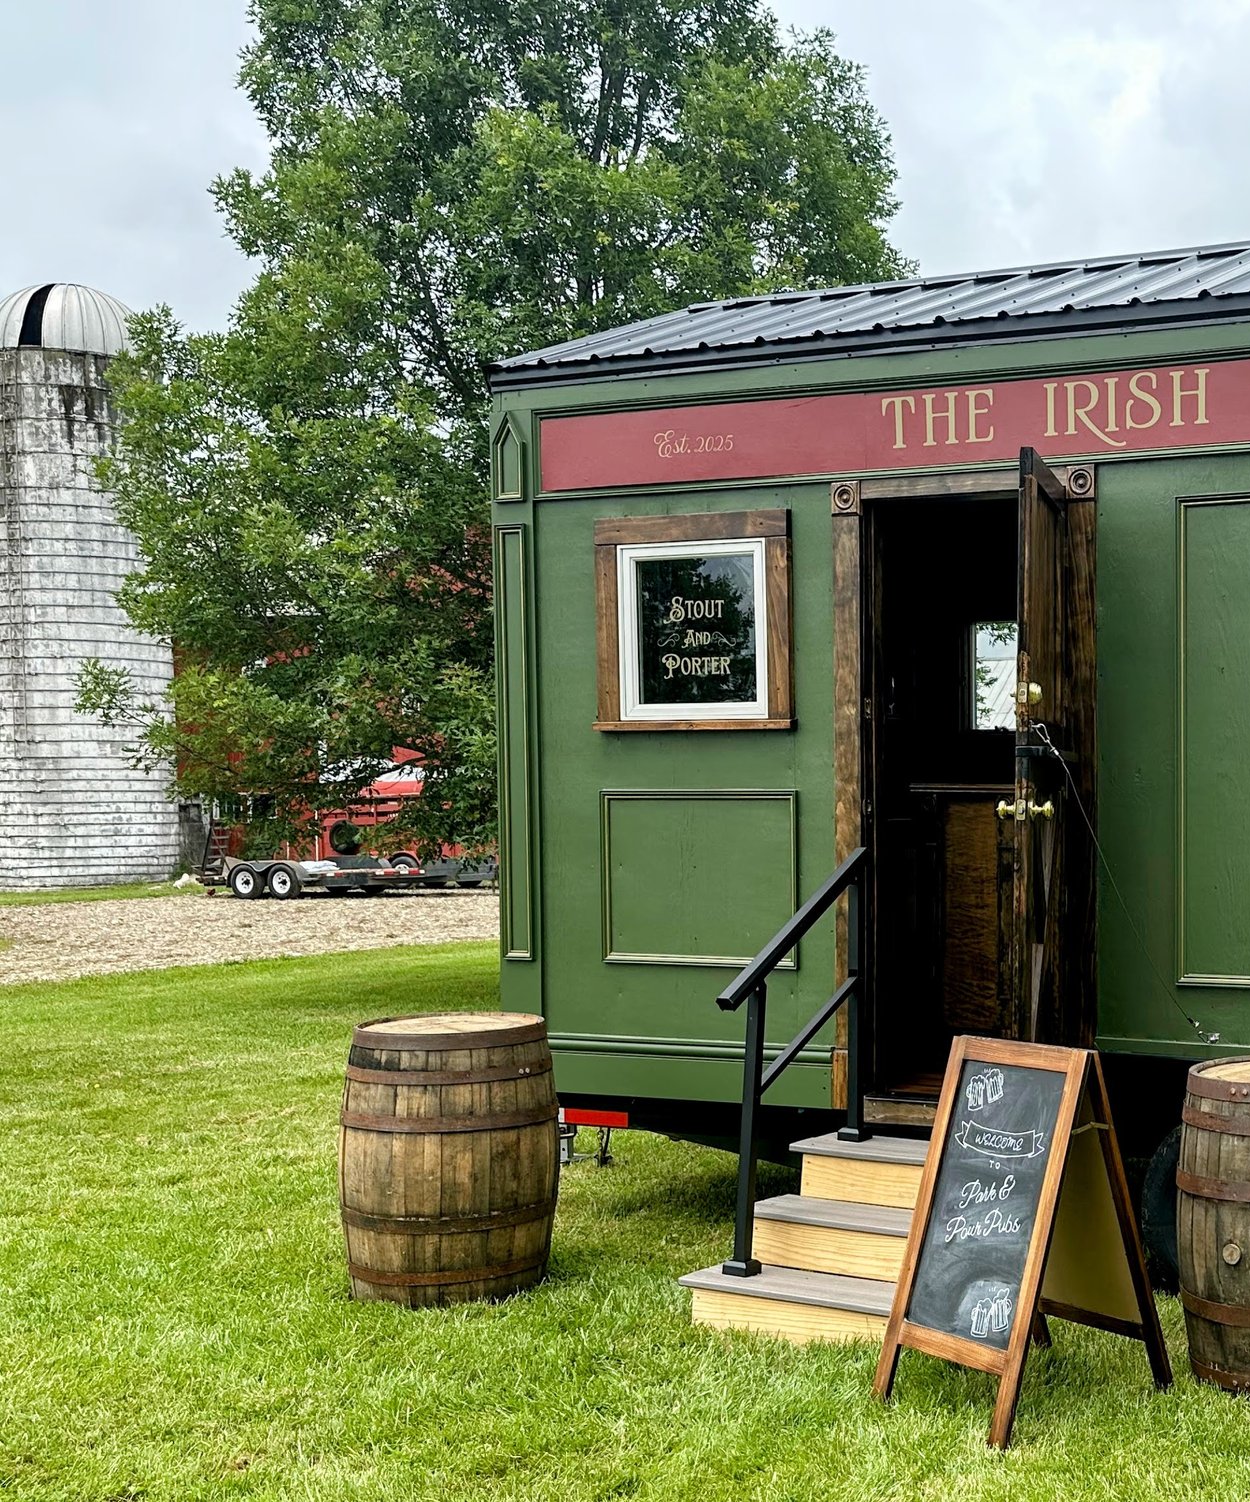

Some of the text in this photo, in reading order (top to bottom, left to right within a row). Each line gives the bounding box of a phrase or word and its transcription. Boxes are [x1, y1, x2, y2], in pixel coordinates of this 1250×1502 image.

[881, 388, 995, 449] THE
[1043, 366, 1210, 447] IRISH
[653, 429, 734, 458] Est. 2025
[989, 1159, 1001, 1170] TO
[959, 1175, 1016, 1208] Park &
[945, 1208, 1021, 1242] Pour Pubs
